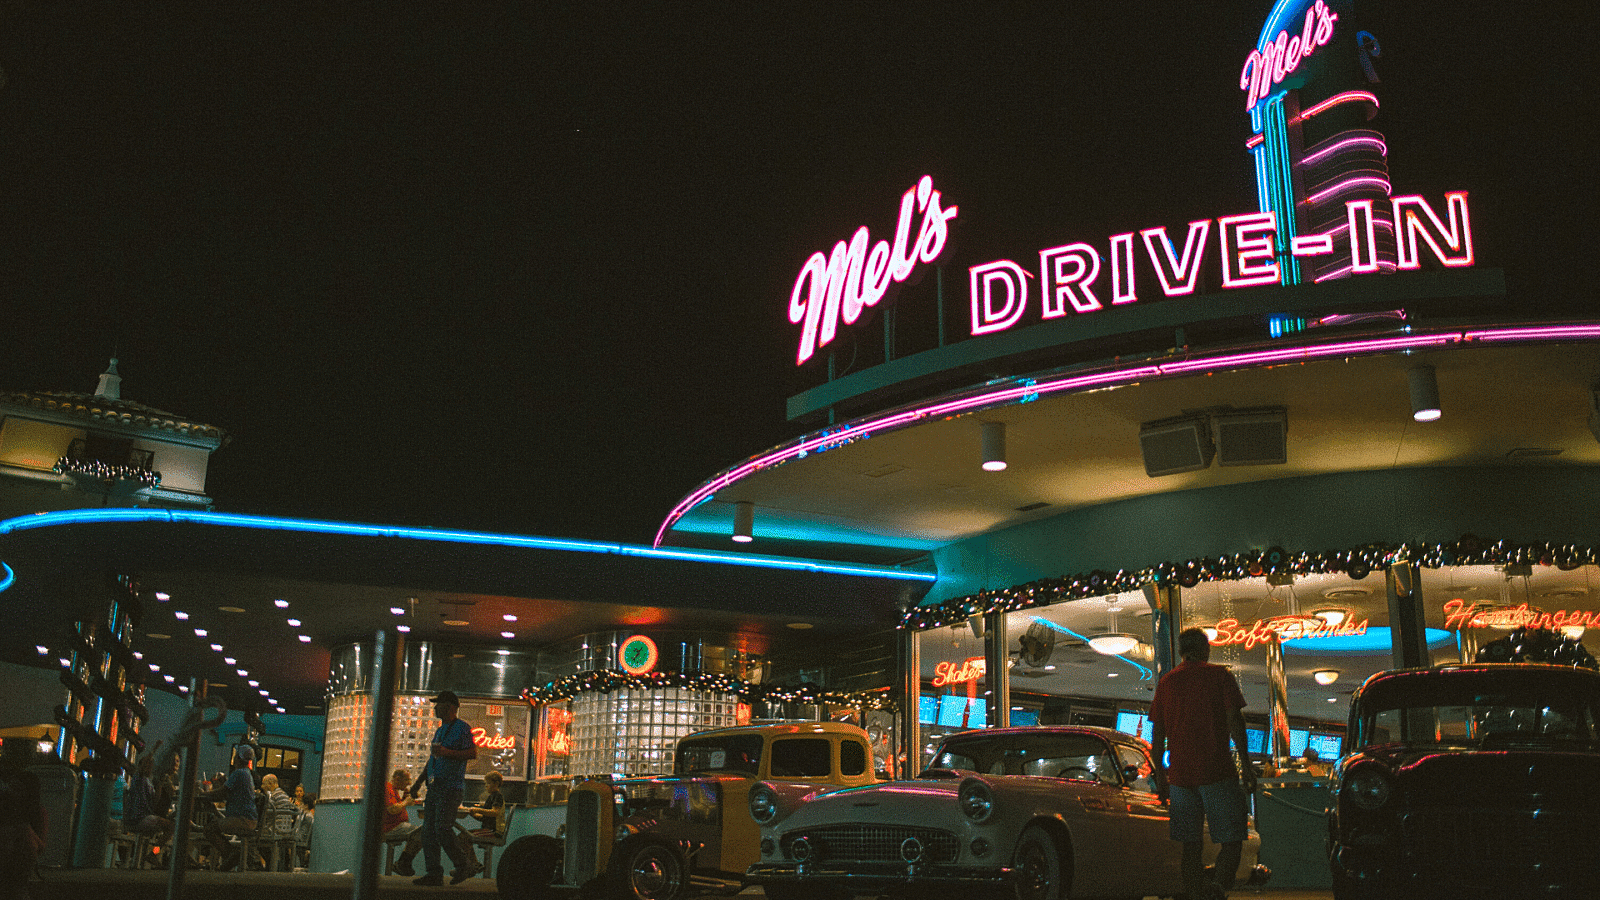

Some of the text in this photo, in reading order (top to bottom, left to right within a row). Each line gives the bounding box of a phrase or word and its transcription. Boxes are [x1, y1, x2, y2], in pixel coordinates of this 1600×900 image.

[1239, 0, 1339, 113] Mel's
[788, 174, 1474, 366] Mel's DRIVE-IN
[1208, 612, 1369, 651] Soft Drinks
[931, 660, 985, 688] Shakes
[470, 727, 516, 750] Fries
